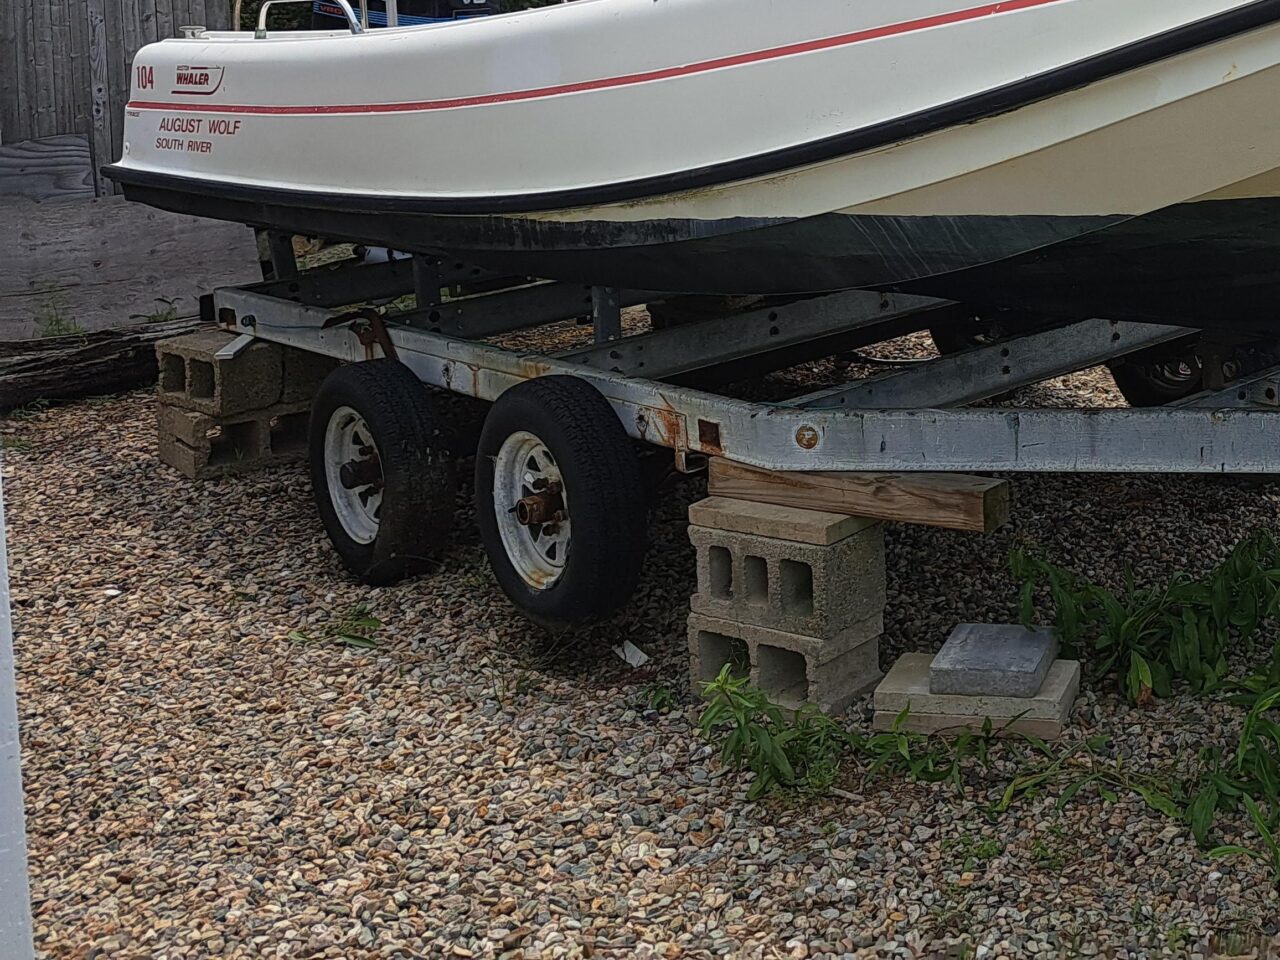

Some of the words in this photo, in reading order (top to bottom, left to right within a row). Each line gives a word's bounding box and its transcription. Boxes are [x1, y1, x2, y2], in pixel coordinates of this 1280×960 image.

[137, 65, 154, 90] 104
[176, 72, 209, 86] WHALER
[158, 117, 203, 134] AUGUST
[207, 119, 242, 136] WOLF
[155, 137, 184, 151] SOUTH
[187, 140, 213, 154] RIVER
